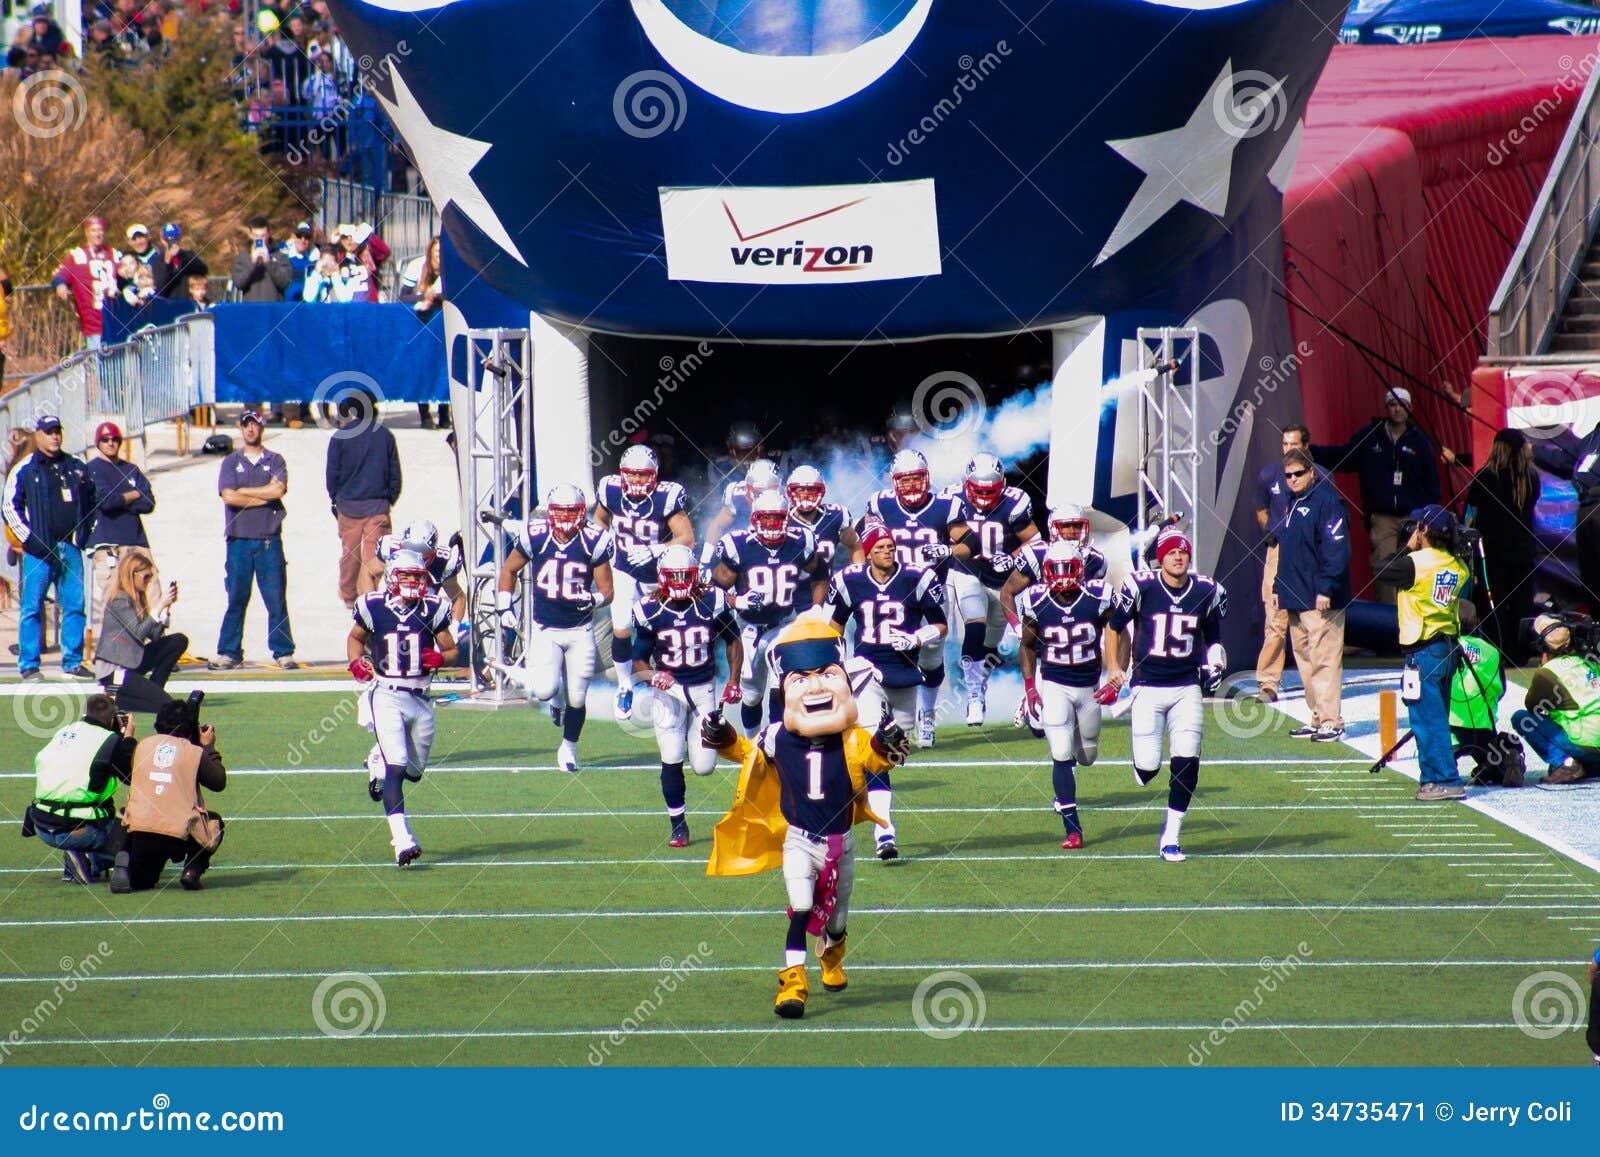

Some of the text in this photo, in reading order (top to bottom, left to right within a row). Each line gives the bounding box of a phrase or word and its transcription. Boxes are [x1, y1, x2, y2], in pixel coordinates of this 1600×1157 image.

[731, 240, 873, 272] verizon
[537, 559, 592, 600] 46
[748, 565, 798, 607] 96
[860, 601, 905, 644] 12
[1044, 622, 1097, 665] 22
[1149, 613, 1199, 658] 15
[383, 633, 420, 677] 11
[657, 626, 709, 667] 38
[805, 751, 825, 800] 1
